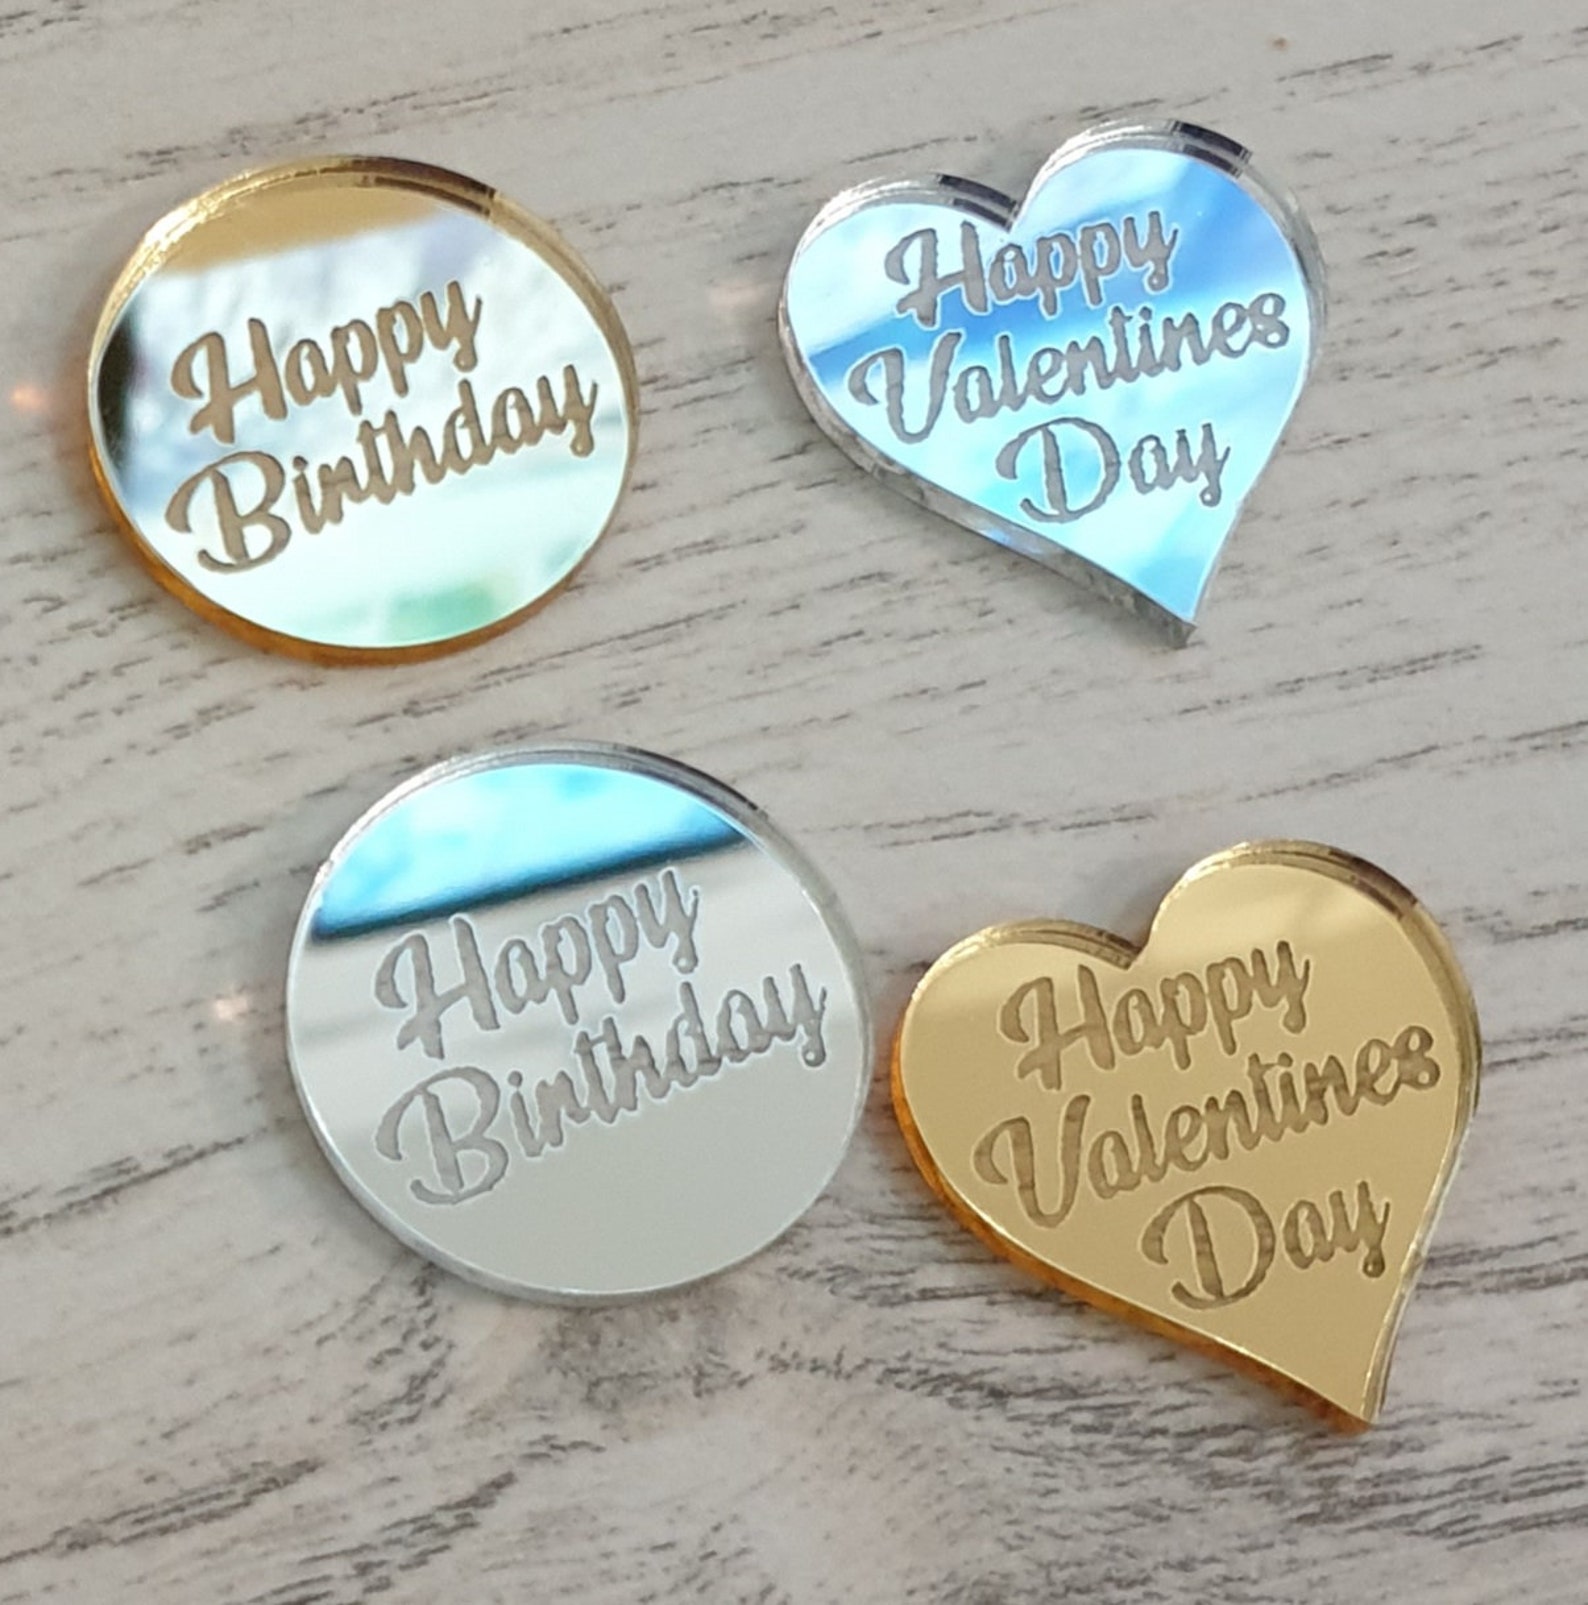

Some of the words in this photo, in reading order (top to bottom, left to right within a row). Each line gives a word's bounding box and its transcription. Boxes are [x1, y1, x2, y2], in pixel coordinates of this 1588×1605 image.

[885, 210, 1178, 327] Happy
[171, 280, 482, 444] Happy
[849, 291, 1290, 445] Valentines
[165, 363, 598, 572] Birthday
[996, 416, 1231, 523] Day
[376, 868, 701, 1060] Happy
[1000, 939, 1310, 1090] Happy
[375, 963, 827, 1206] Birthday
[973, 1024, 1441, 1229] Valentines
[1142, 1180, 1390, 1310] Day
